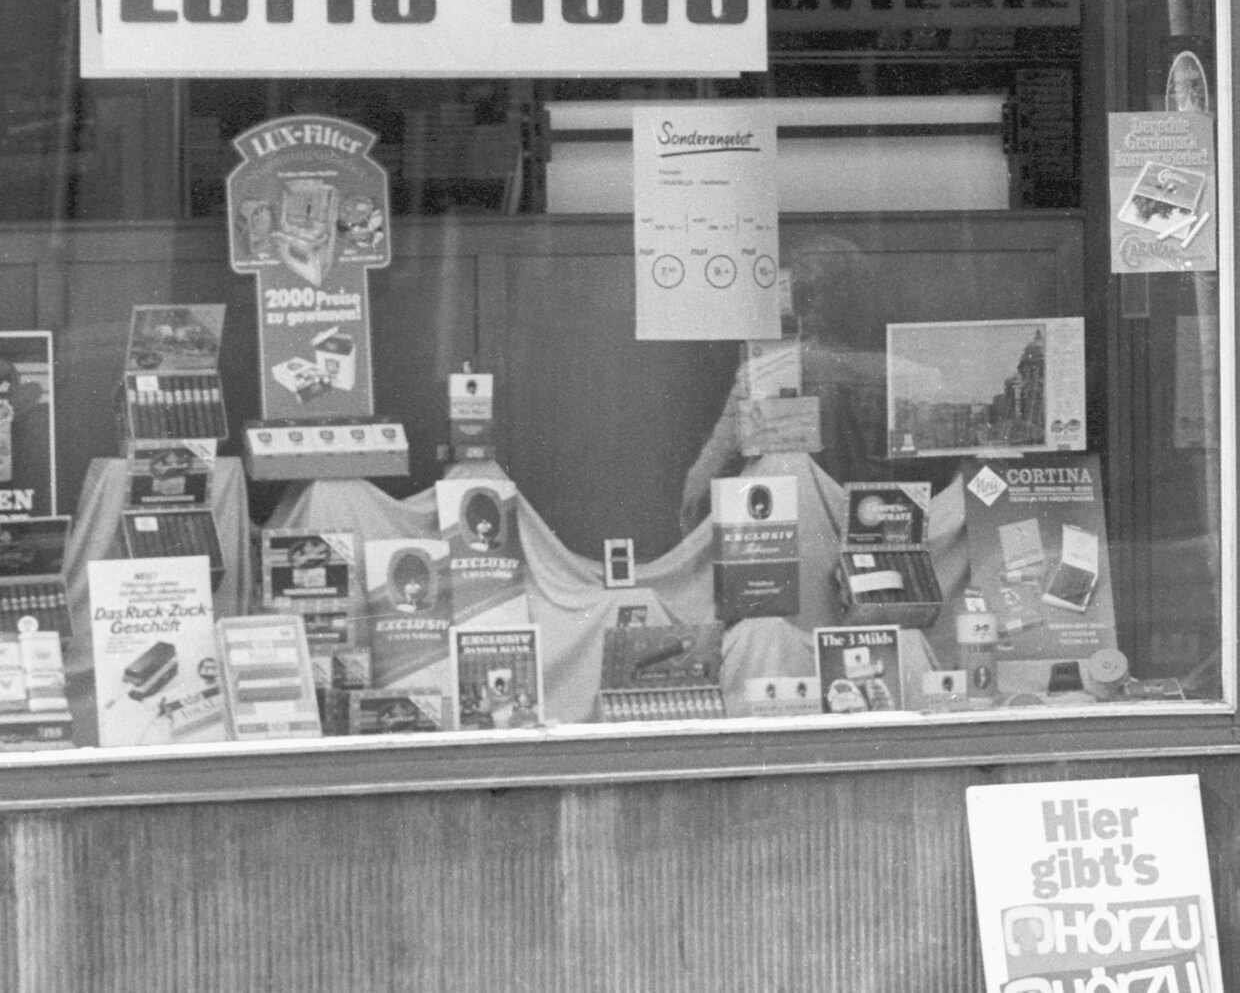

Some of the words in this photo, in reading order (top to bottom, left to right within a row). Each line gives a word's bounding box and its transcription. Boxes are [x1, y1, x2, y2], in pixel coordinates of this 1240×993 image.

[250, 124, 363, 157] LUX-Filter
[658, 121, 755, 147] Sonderangebot
[265, 287, 314, 308] 2000
[1006, 467, 1093, 485] CORTINA
[450, 557, 520, 570] EXCLUSIV
[375, 618, 451, 632] EXCLUSIV
[821, 635, 846, 647] The
[857, 632, 893, 646] Milds
[1041, 798, 1139, 842] Hier
[1030, 844, 1160, 899] gibt's
